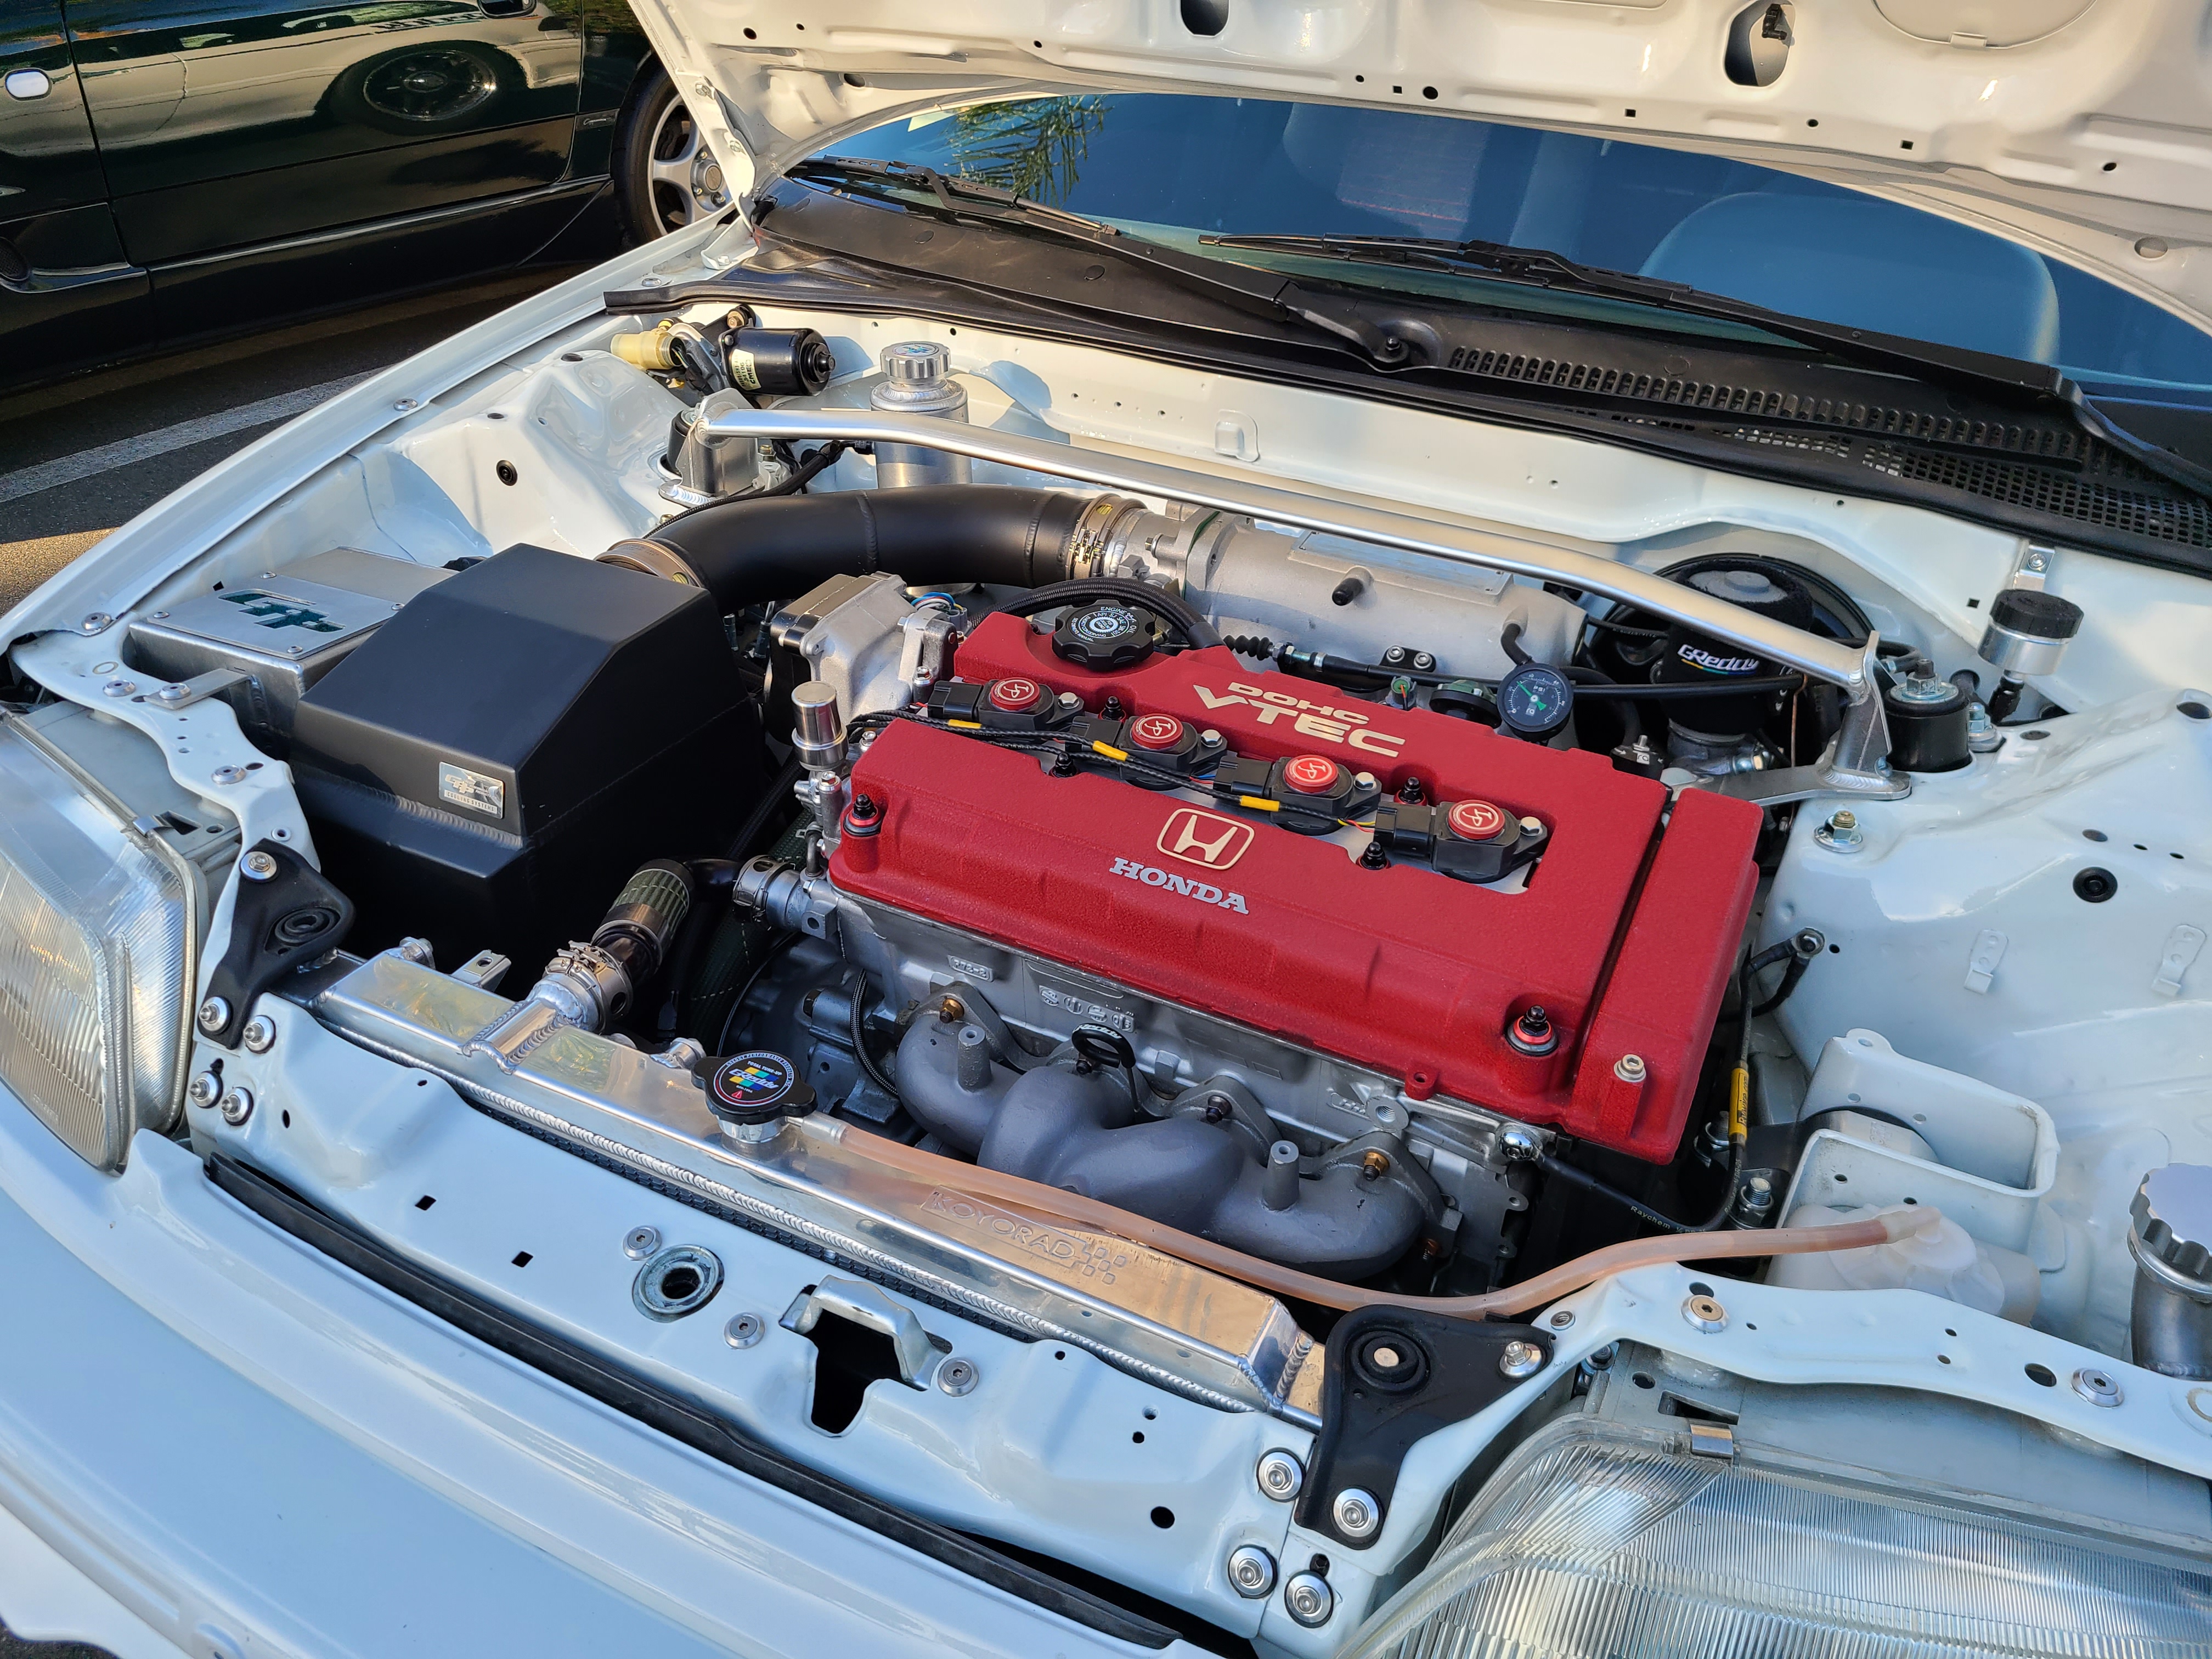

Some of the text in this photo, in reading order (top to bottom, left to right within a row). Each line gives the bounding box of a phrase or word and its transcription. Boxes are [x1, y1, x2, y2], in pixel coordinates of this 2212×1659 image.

[1101, 606, 1137, 634] ENGINE OIL
[1193, 684, 1406, 758] VTEC
[1228, 682, 1370, 725] DOHC
[471, 799, 494, 811] SYSTEMS
[1109, 857, 1250, 915] HONDA
[729, 1068, 779, 1089] GReddy
[933, 1190, 1076, 1260] KOYORAD
[1630, 1205, 1671, 1229] Raychem
